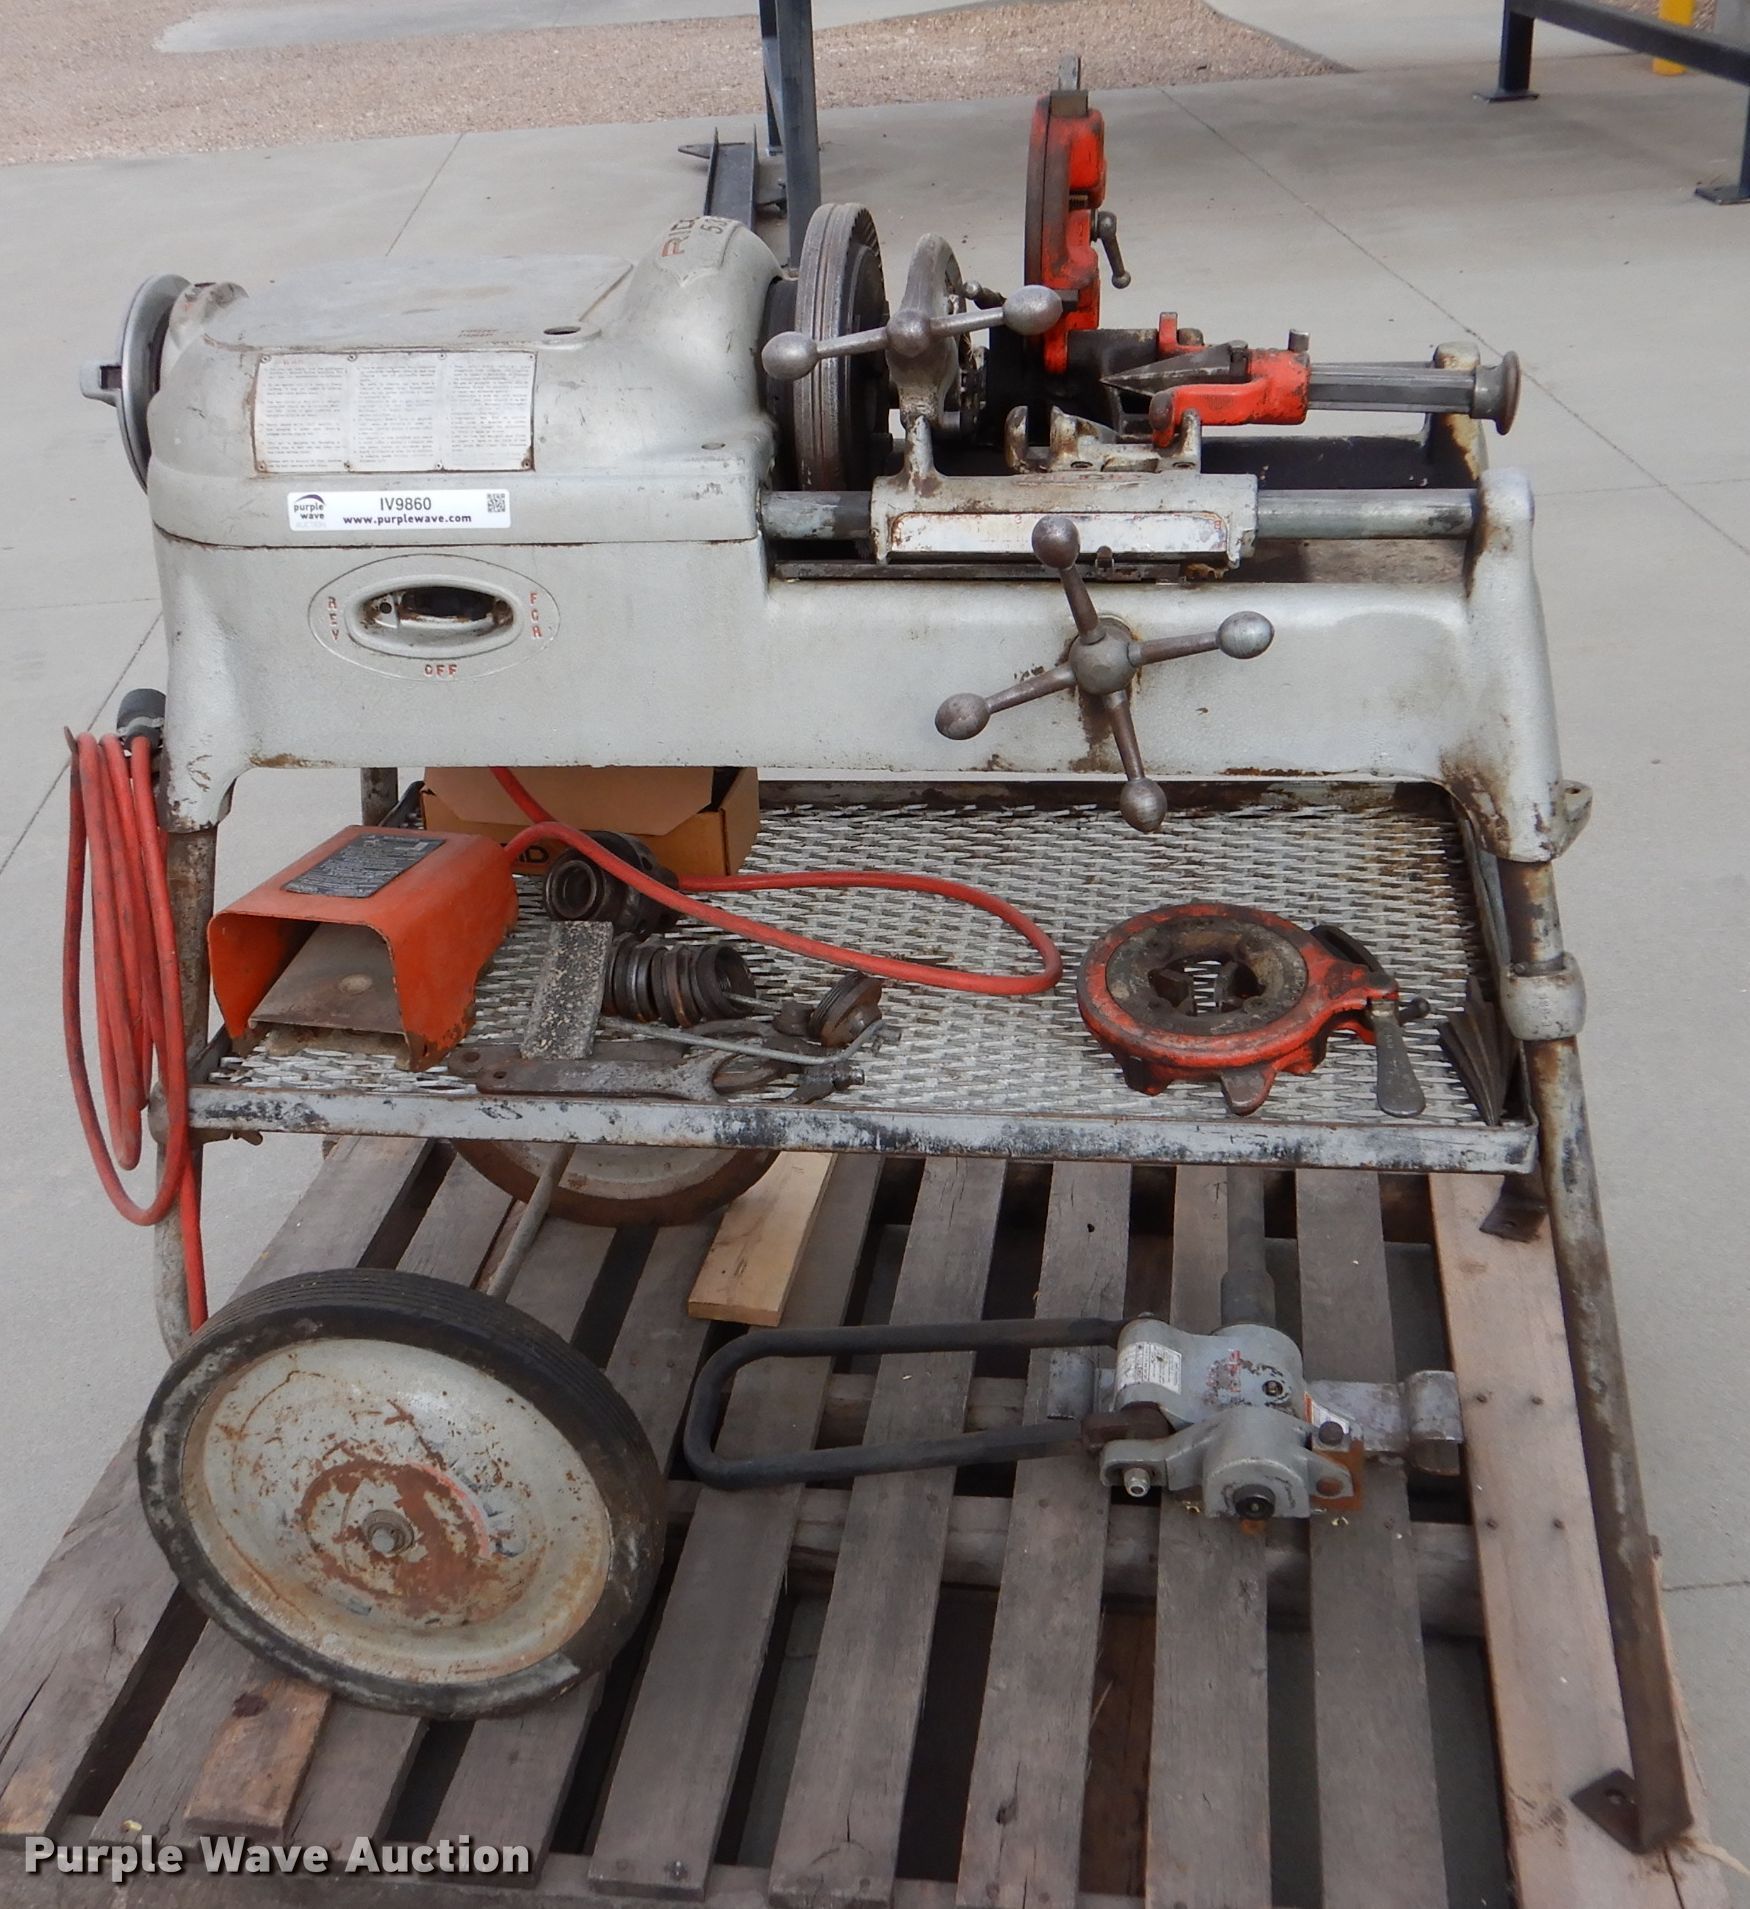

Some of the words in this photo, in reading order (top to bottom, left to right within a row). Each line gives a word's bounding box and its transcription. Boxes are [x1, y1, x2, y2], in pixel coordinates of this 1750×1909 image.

[293, 503, 325, 513] purple
[380, 497, 432, 511] IV9860
[342, 513, 472, 526] www.purplewave.com
[424, 664, 458, 676] OFF
